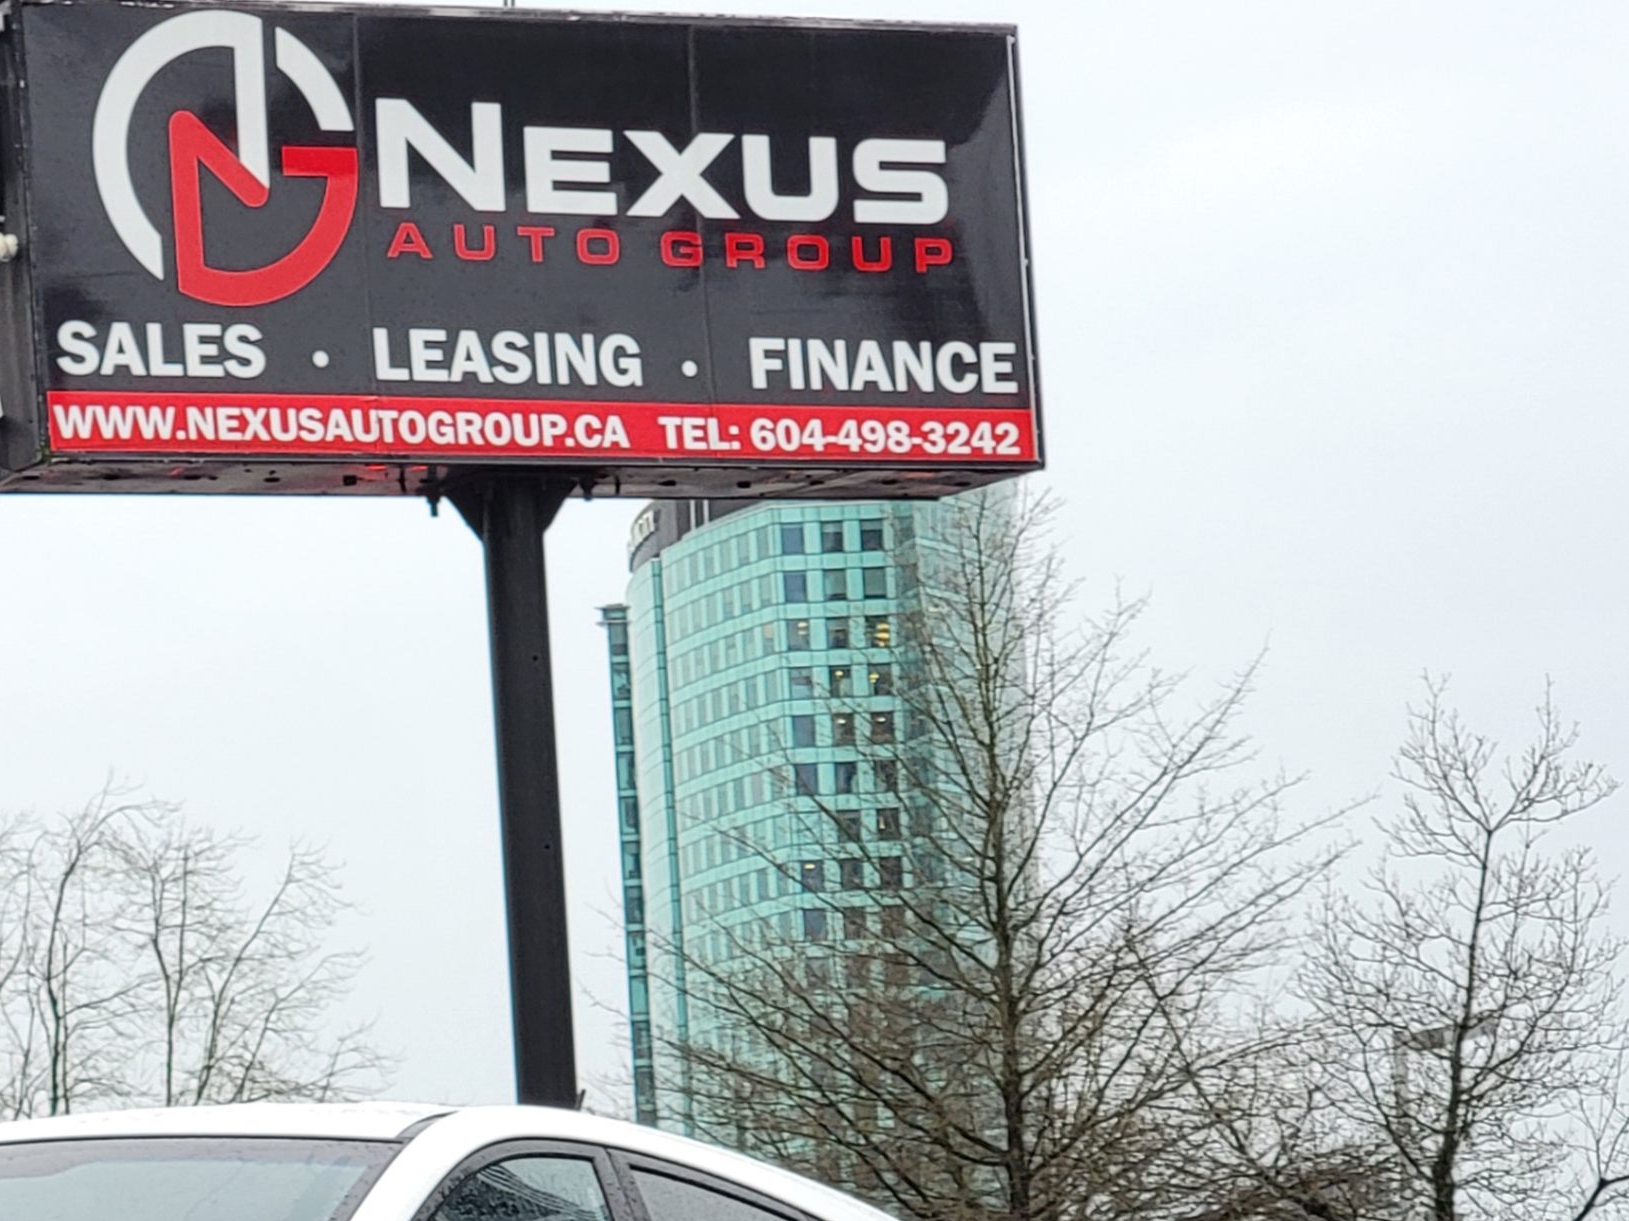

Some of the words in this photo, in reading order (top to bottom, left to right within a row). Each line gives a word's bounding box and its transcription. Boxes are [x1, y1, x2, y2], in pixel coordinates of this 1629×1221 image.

[375, 97, 949, 225] NEXUS
[386, 221, 621, 266] AUTO
[659, 230, 954, 274] GROUP
[55, 320, 267, 379] SALES
[372, 327, 644, 388] LEASING
[748, 336, 1019, 394] FINANCE
[52, 404, 631, 449] WWW.NEXUSAUTOGROUP.CA
[657, 415, 741, 451] TEL:
[749, 418, 1021, 455] 604-498-3242
